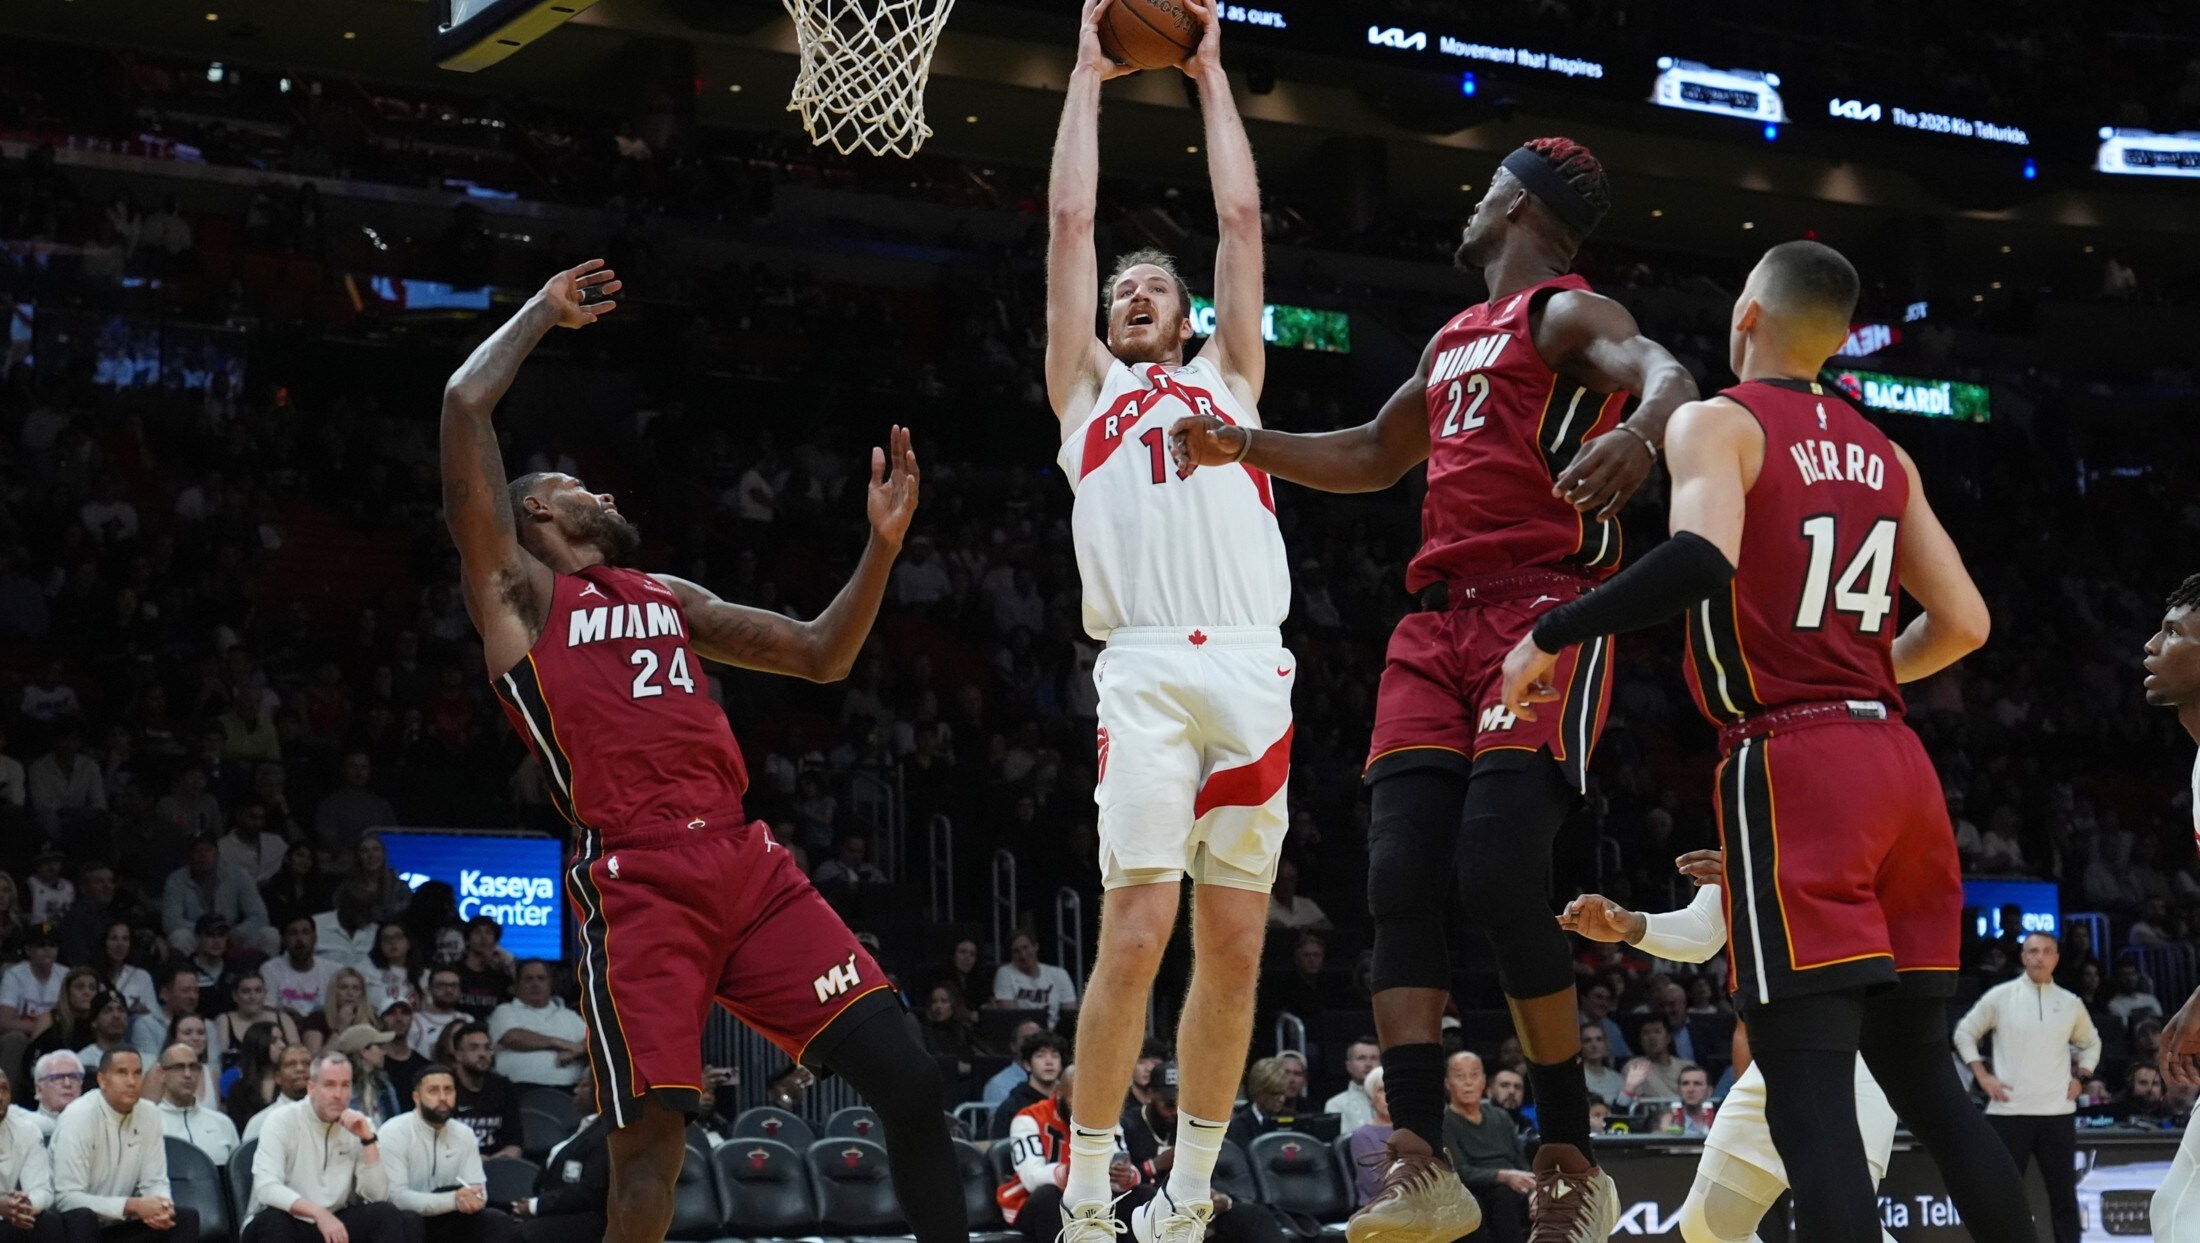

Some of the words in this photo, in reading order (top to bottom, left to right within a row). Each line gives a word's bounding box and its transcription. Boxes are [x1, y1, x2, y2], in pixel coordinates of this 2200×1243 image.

[1227, 5, 1246, 22] as
[1247, 8, 1287, 28] ours.
[1439, 36, 1516, 63] Movement
[1517, 49, 1546, 68] that
[1548, 53, 1603, 78] inspires
[1891, 107, 1918, 128] The
[1918, 112, 1950, 132] 2025
[1950, 117, 1973, 136] Kia
[1426, 333, 1512, 388] MIAMI
[1440, 372, 1490, 438] 22
[1790, 439, 1884, 491] HERRO
[1793, 514, 1898, 634] 14
[567, 601, 684, 647] MIAMI
[630, 647, 694, 699] 24
[460, 869, 553, 905] Kaseya
[459, 896, 553, 926] Center
